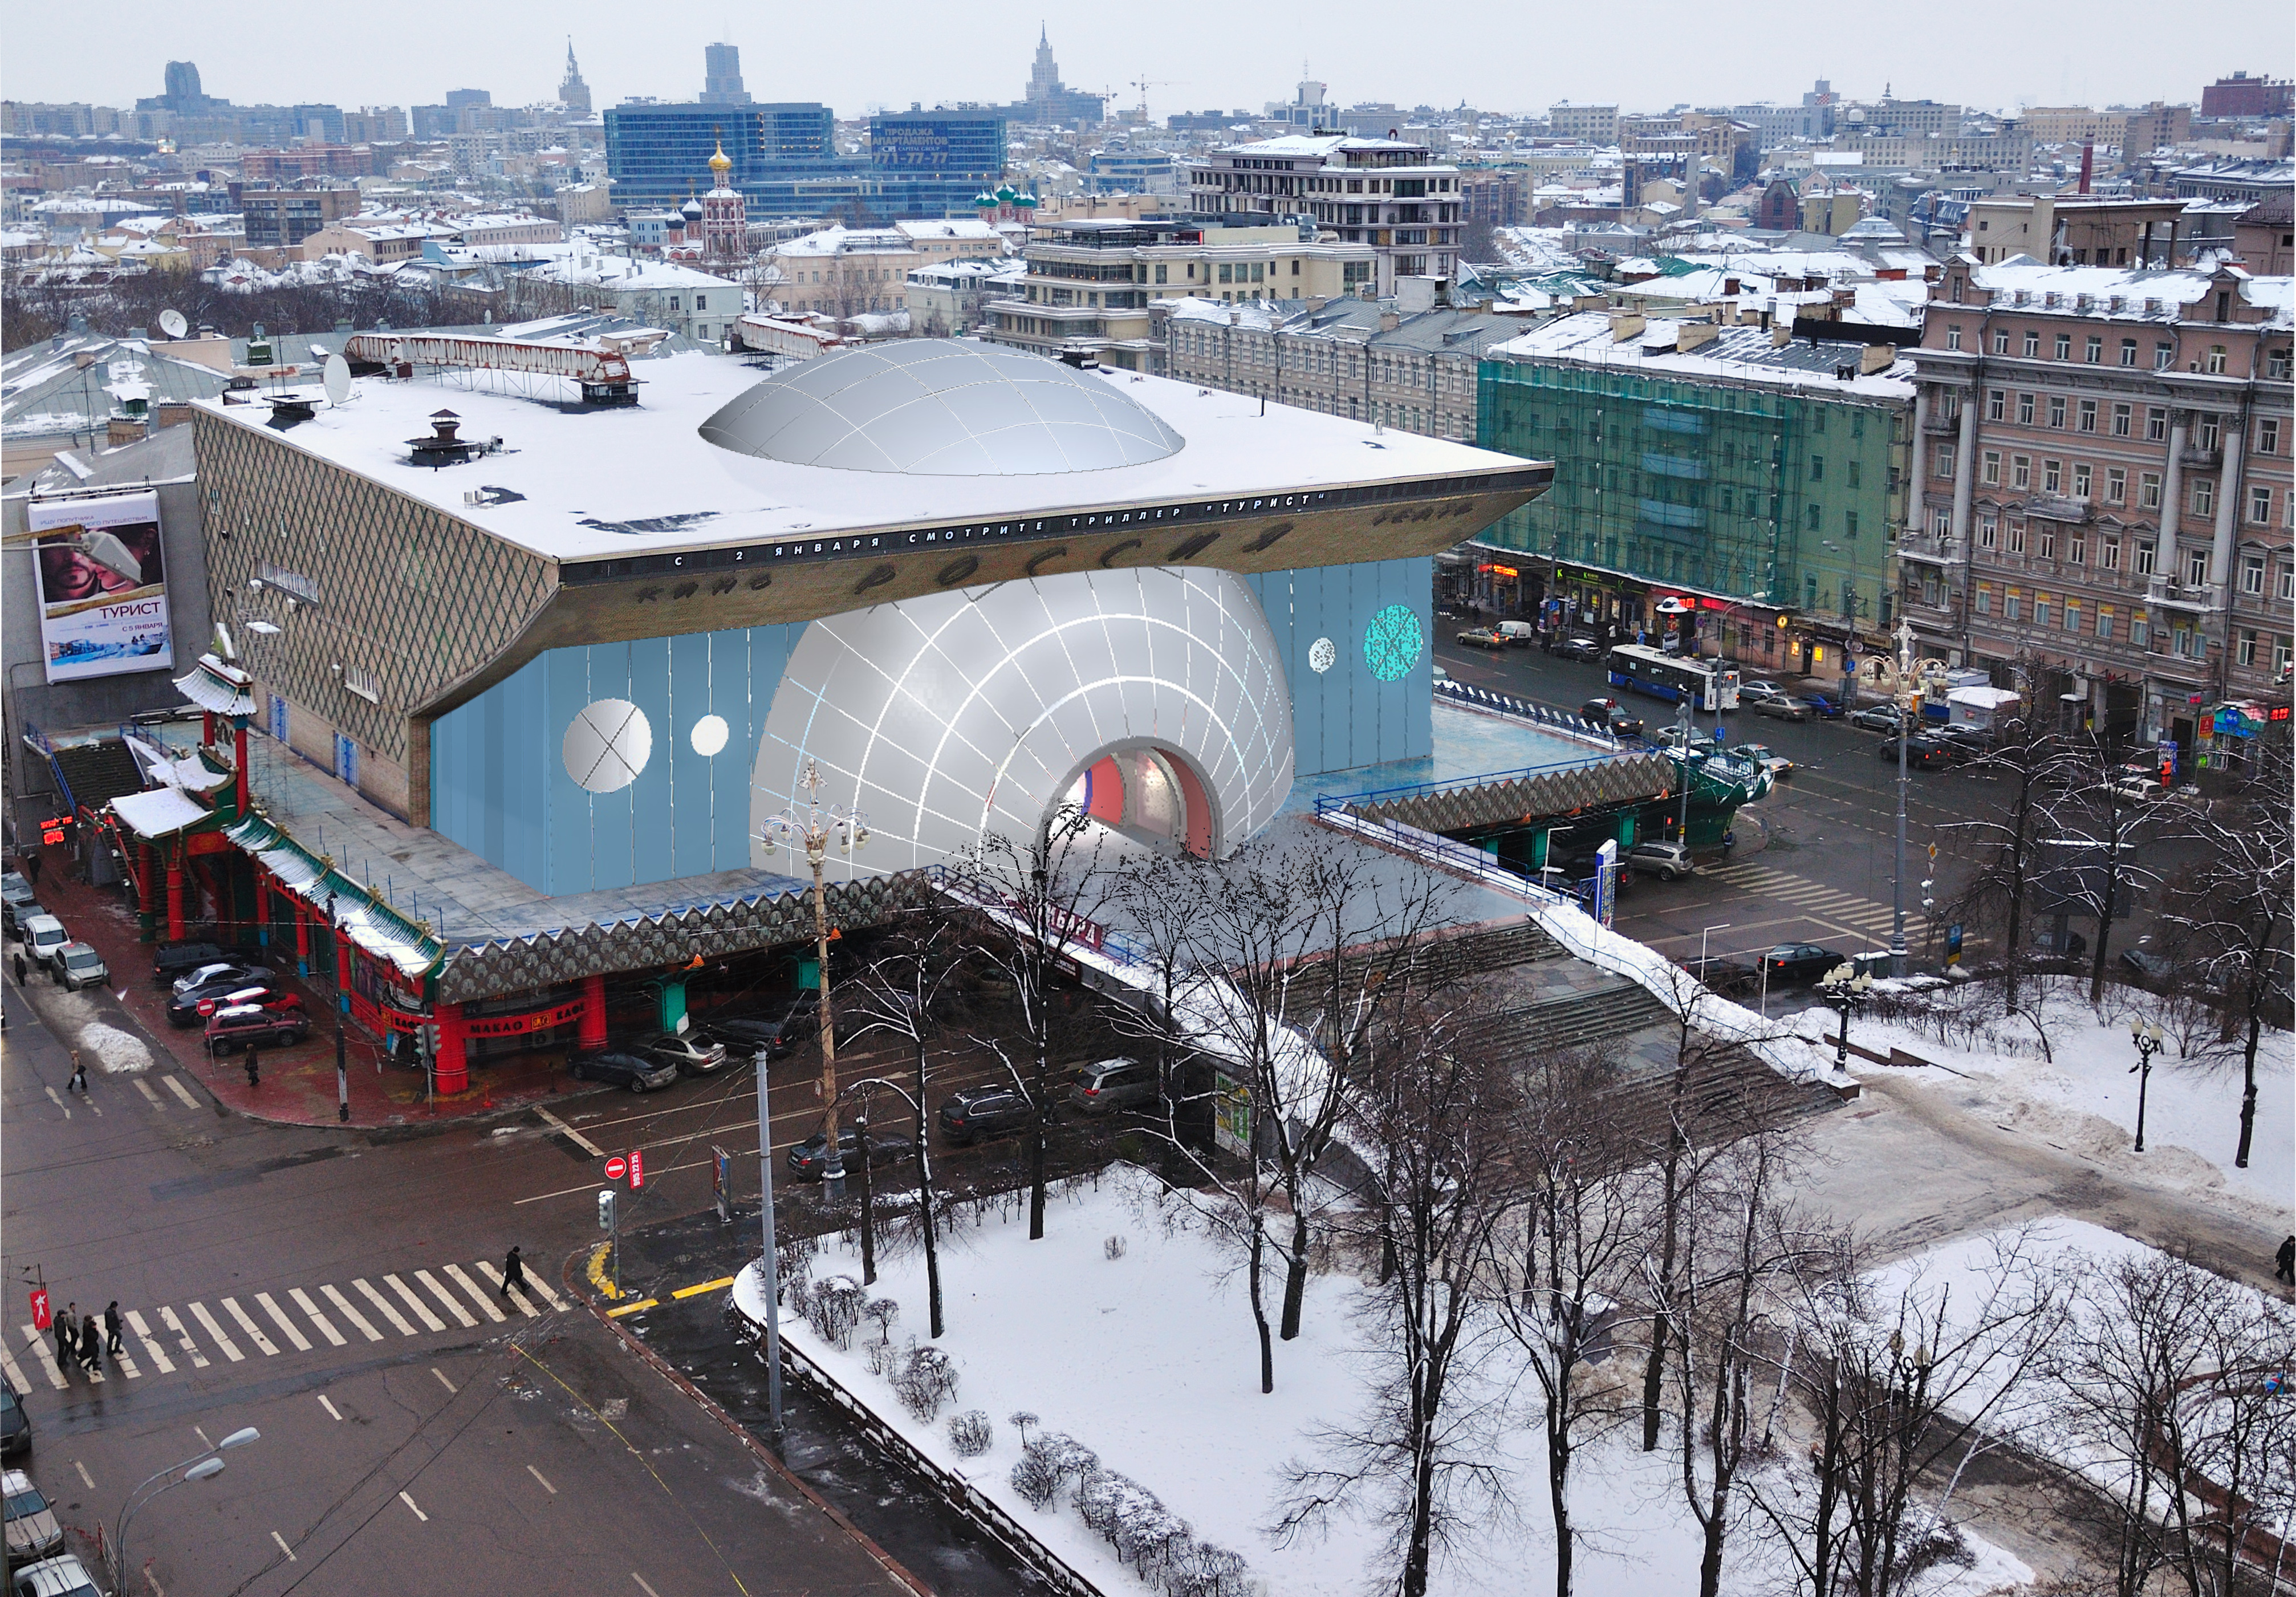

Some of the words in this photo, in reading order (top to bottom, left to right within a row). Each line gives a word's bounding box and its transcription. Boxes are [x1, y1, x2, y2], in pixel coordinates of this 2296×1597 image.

[872, 136, 948, 145] АПАРТАМЕНТОВ
[872, 152, 948, 164] 771-77-77
[675, 556, 682, 566] С
[735, 551, 743, 560] 2
[775, 537, 879, 557] ЯНВАРЯ
[909, 521, 1043, 543] СМОТРИТЕ
[1072, 507, 1180, 527] ТРИЛЛЕР
[100, 602, 160, 619] ТУРИСТ
[470, 1021, 522, 1033] МАКАО
[631, 1155, 639, 1164] 25
[632, 1164, 640, 1173] 22
